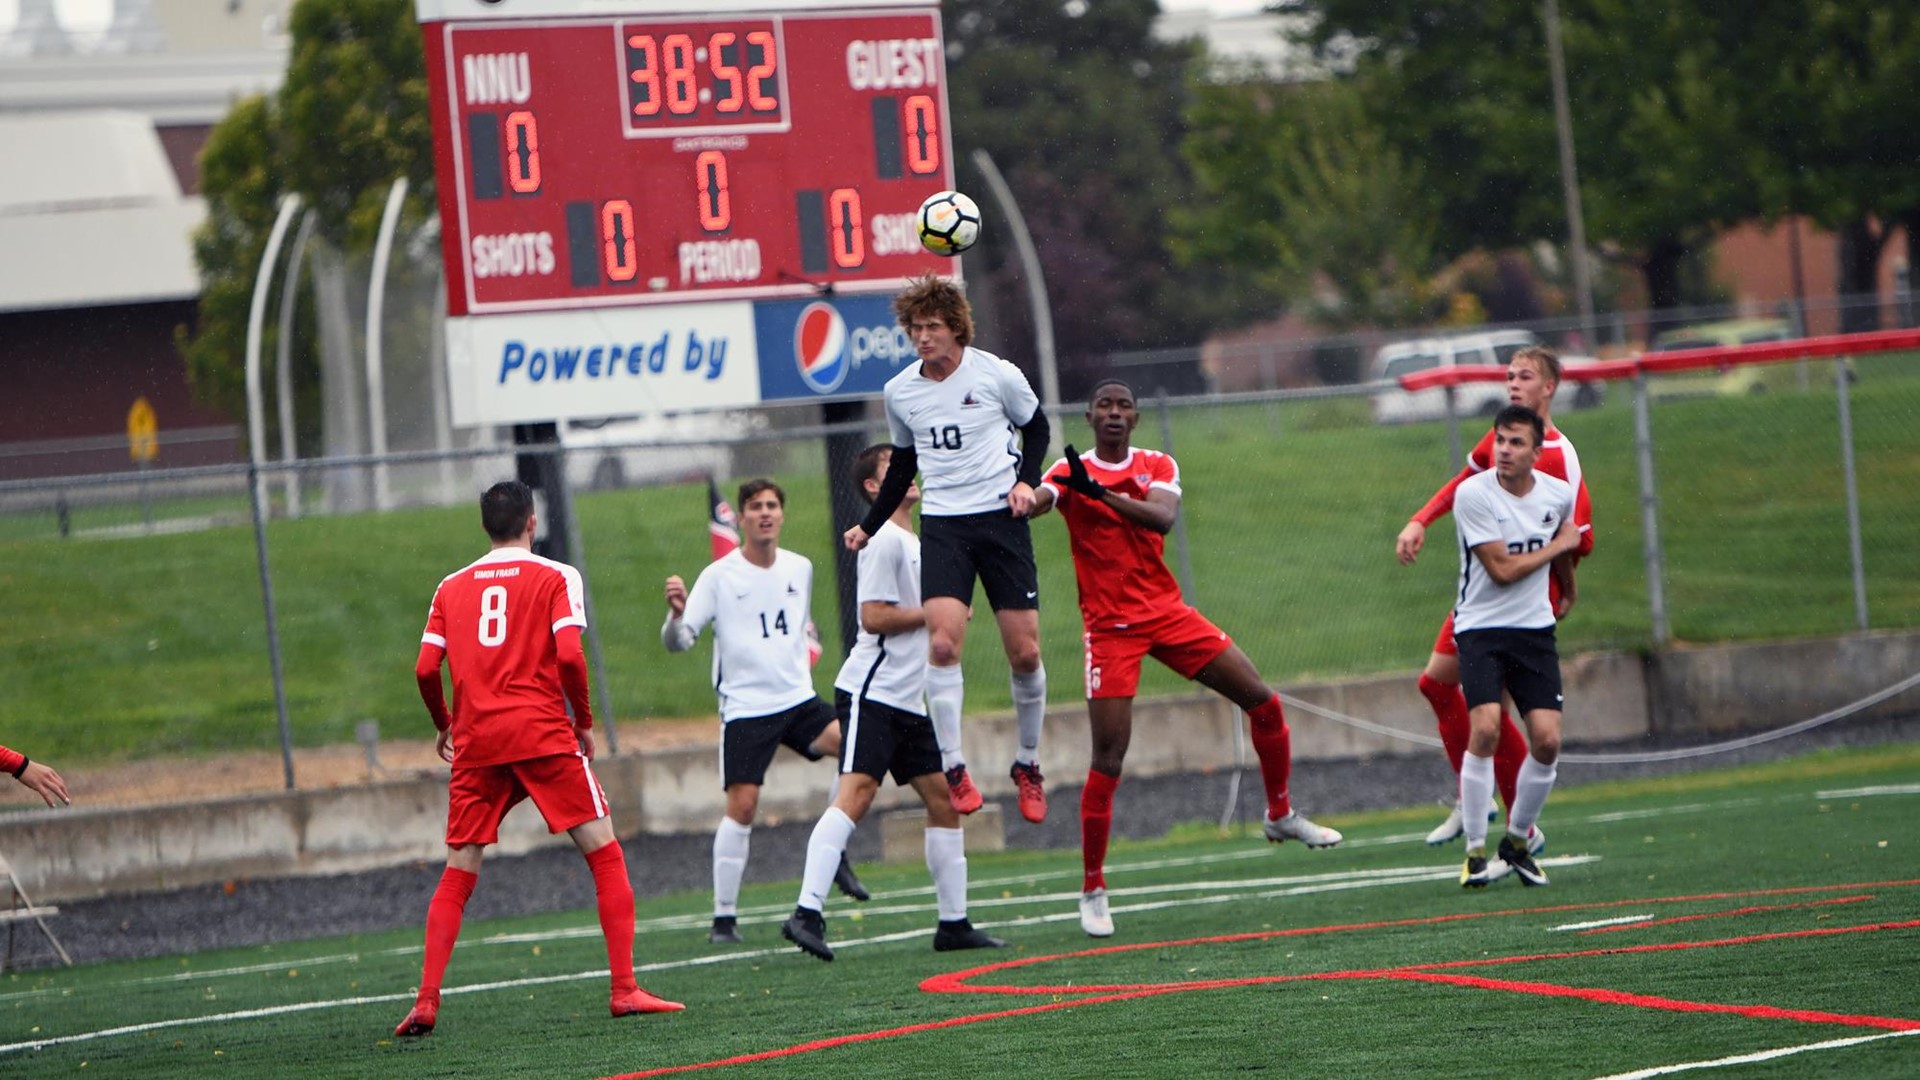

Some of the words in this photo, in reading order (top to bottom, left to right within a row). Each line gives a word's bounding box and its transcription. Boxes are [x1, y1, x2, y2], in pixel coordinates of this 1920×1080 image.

[463, 53, 531, 104] NNU
[628, 31, 778, 116] 38:52
[847, 38, 939, 90] GUEST
[506, 111, 541, 193] 0
[905, 95, 938, 175] 0
[697, 150, 731, 232] 0
[602, 200, 637, 282] 0
[830, 188, 865, 268] 0
[872, 211, 921, 256] SHO
[472, 232, 555, 278] SHOTS
[679, 240, 761, 285] PERIOD
[499, 331, 671, 384] Powered
[685, 329, 727, 380] by
[851, 325, 917, 369] pep
[930, 425, 962, 450] 10
[473, 569, 496, 580] SIMON
[496, 566, 520, 579] FRASER
[478, 585, 507, 647] 8
[760, 609, 788, 638] 14
